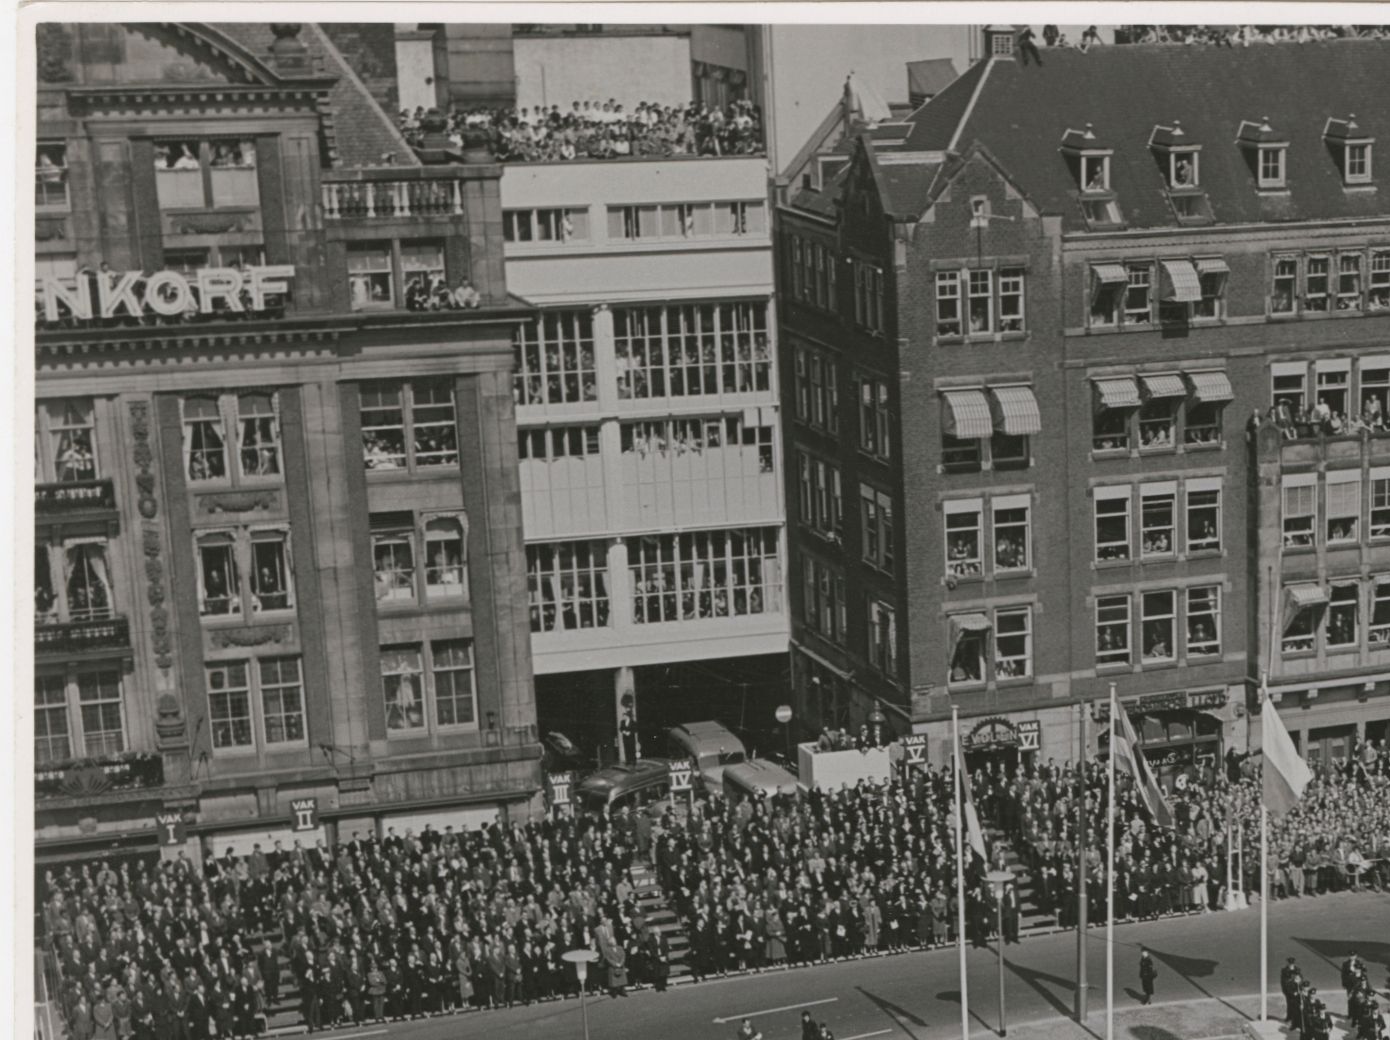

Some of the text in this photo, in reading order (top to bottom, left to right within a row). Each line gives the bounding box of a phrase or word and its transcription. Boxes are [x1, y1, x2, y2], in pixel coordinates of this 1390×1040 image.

[1019, 722, 1039, 732] VAK
[905, 736, 925, 745] VAK
[1018, 732, 1040, 750] VI
[906, 745, 925, 763] V
[669, 761, 690, 771] VAK
[549, 774, 571, 784] VAK
[669, 771, 692, 791] IV
[553, 784, 570, 804] III
[292, 800, 315, 810] VAK
[158, 813, 182, 824] VAK
[296, 810, 314, 830] II
[166, 824, 178, 844] I
